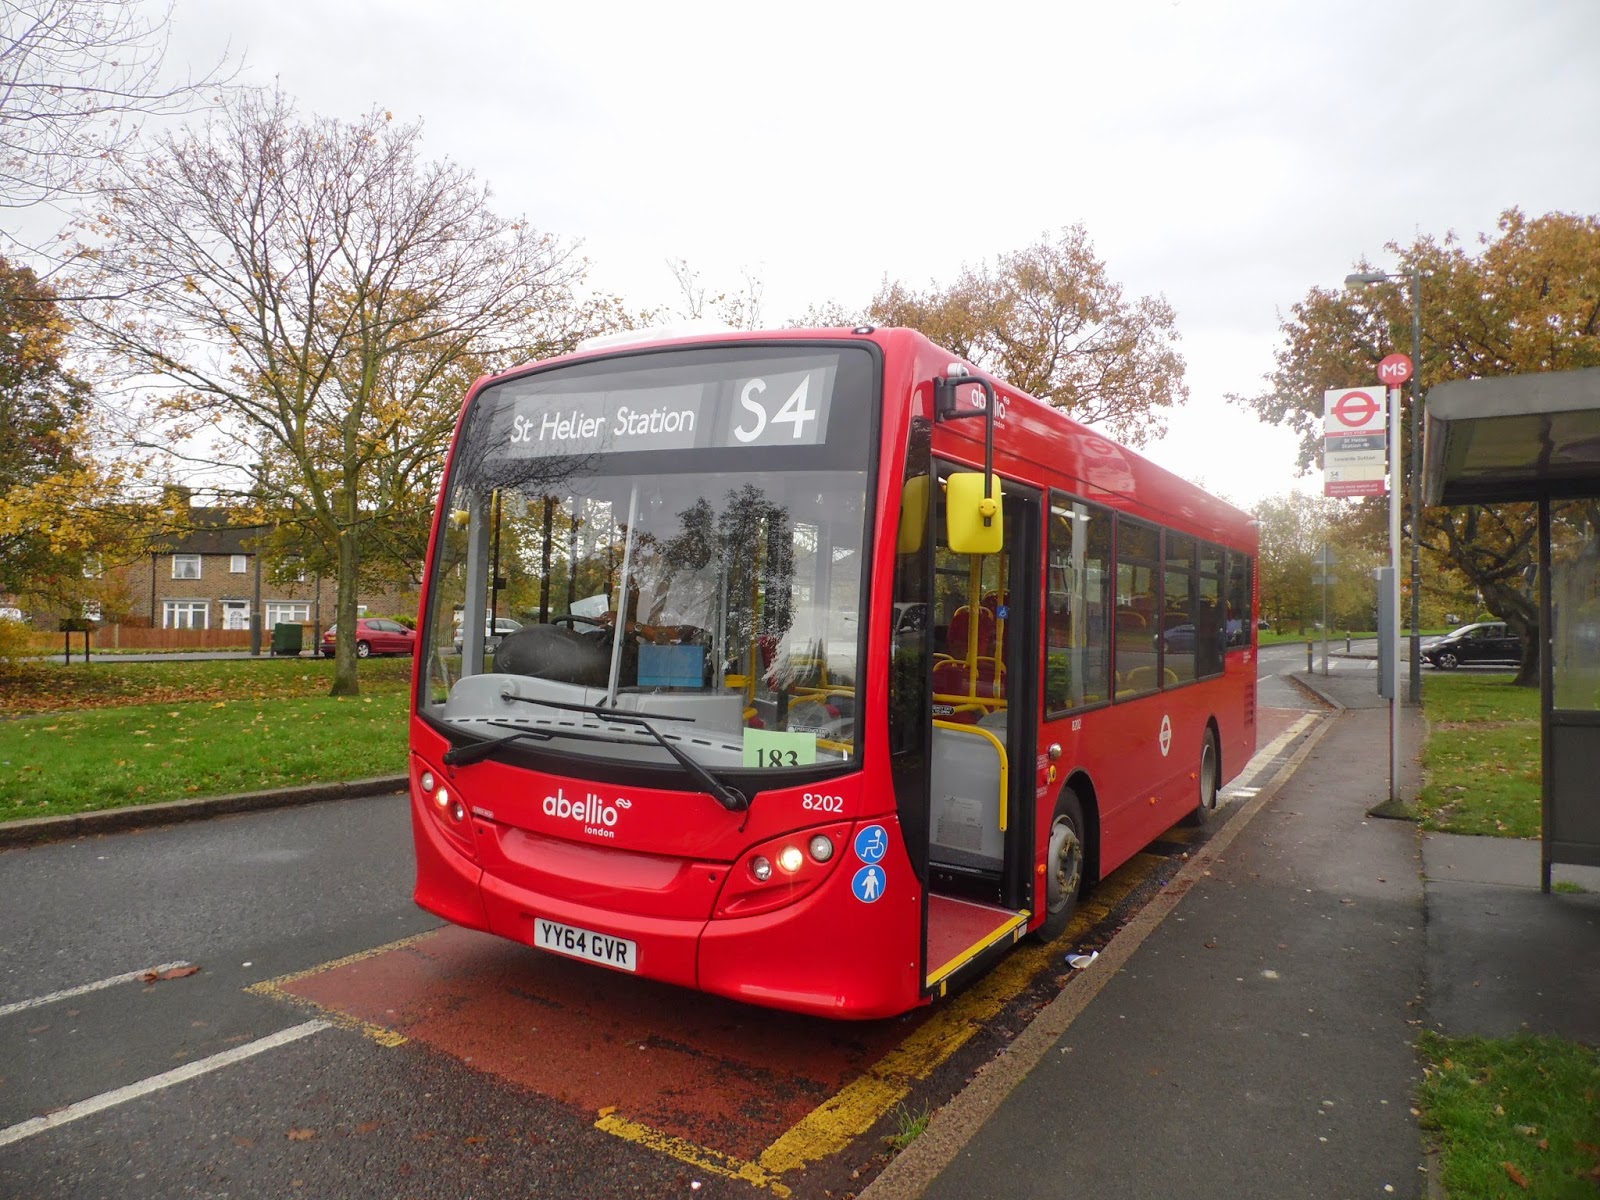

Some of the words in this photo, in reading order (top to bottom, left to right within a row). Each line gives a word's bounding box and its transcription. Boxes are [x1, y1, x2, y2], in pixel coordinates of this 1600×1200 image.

[1382, 362, 1407, 377] MS
[510, 414, 534, 443] St
[539, 410, 606, 442] Helier
[613, 405, 695, 436] Station
[733, 373, 817, 443] S4
[756, 748, 798, 767] 183
[542, 788, 618, 826] abellio
[802, 793, 843, 813] 8202
[584, 825, 615, 838] london
[542, 922, 587, 953] YY64
[592, 935, 627, 964] GVR
